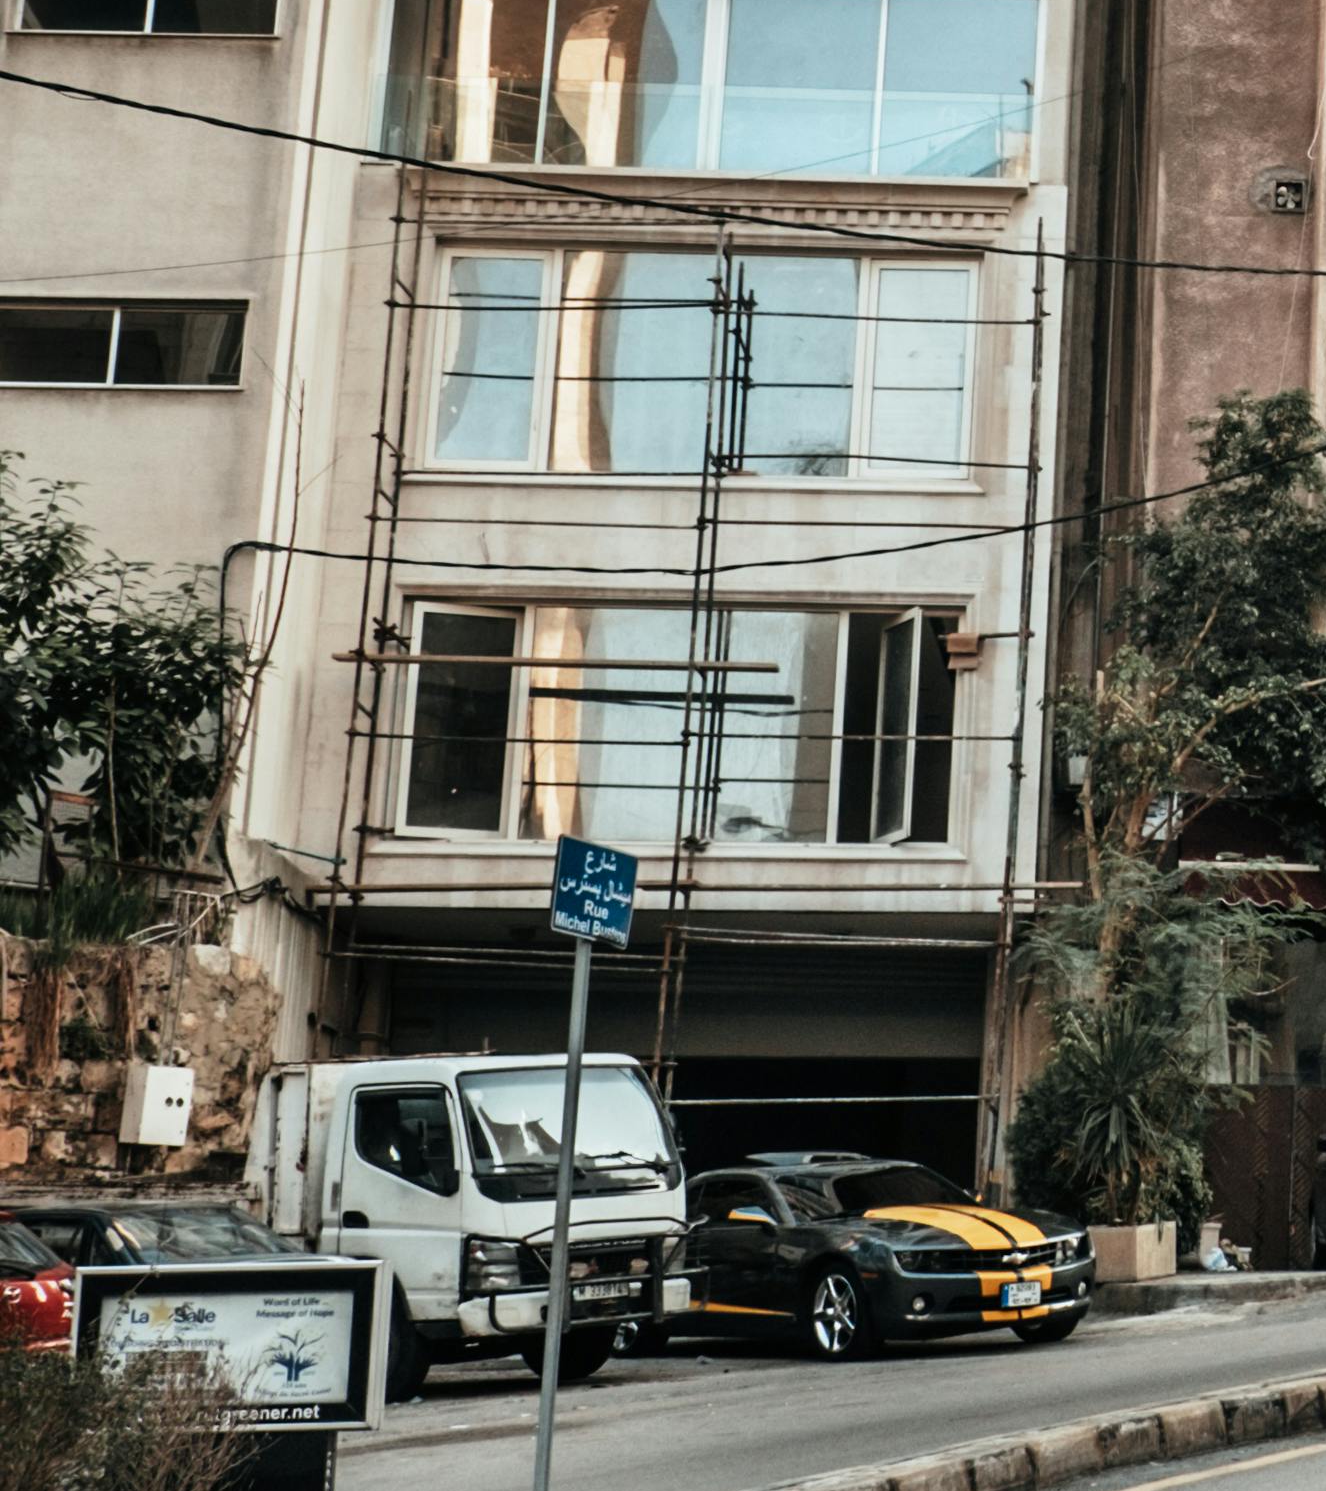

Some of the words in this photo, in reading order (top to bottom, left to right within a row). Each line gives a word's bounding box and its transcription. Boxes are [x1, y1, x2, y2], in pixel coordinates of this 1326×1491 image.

[585, 851, 616, 874] شارع
[584, 899, 609, 921] Rue
[555, 910, 590, 934] Michel
[131, 1309, 150, 1324] La
[174, 1305, 217, 1324] Salle
